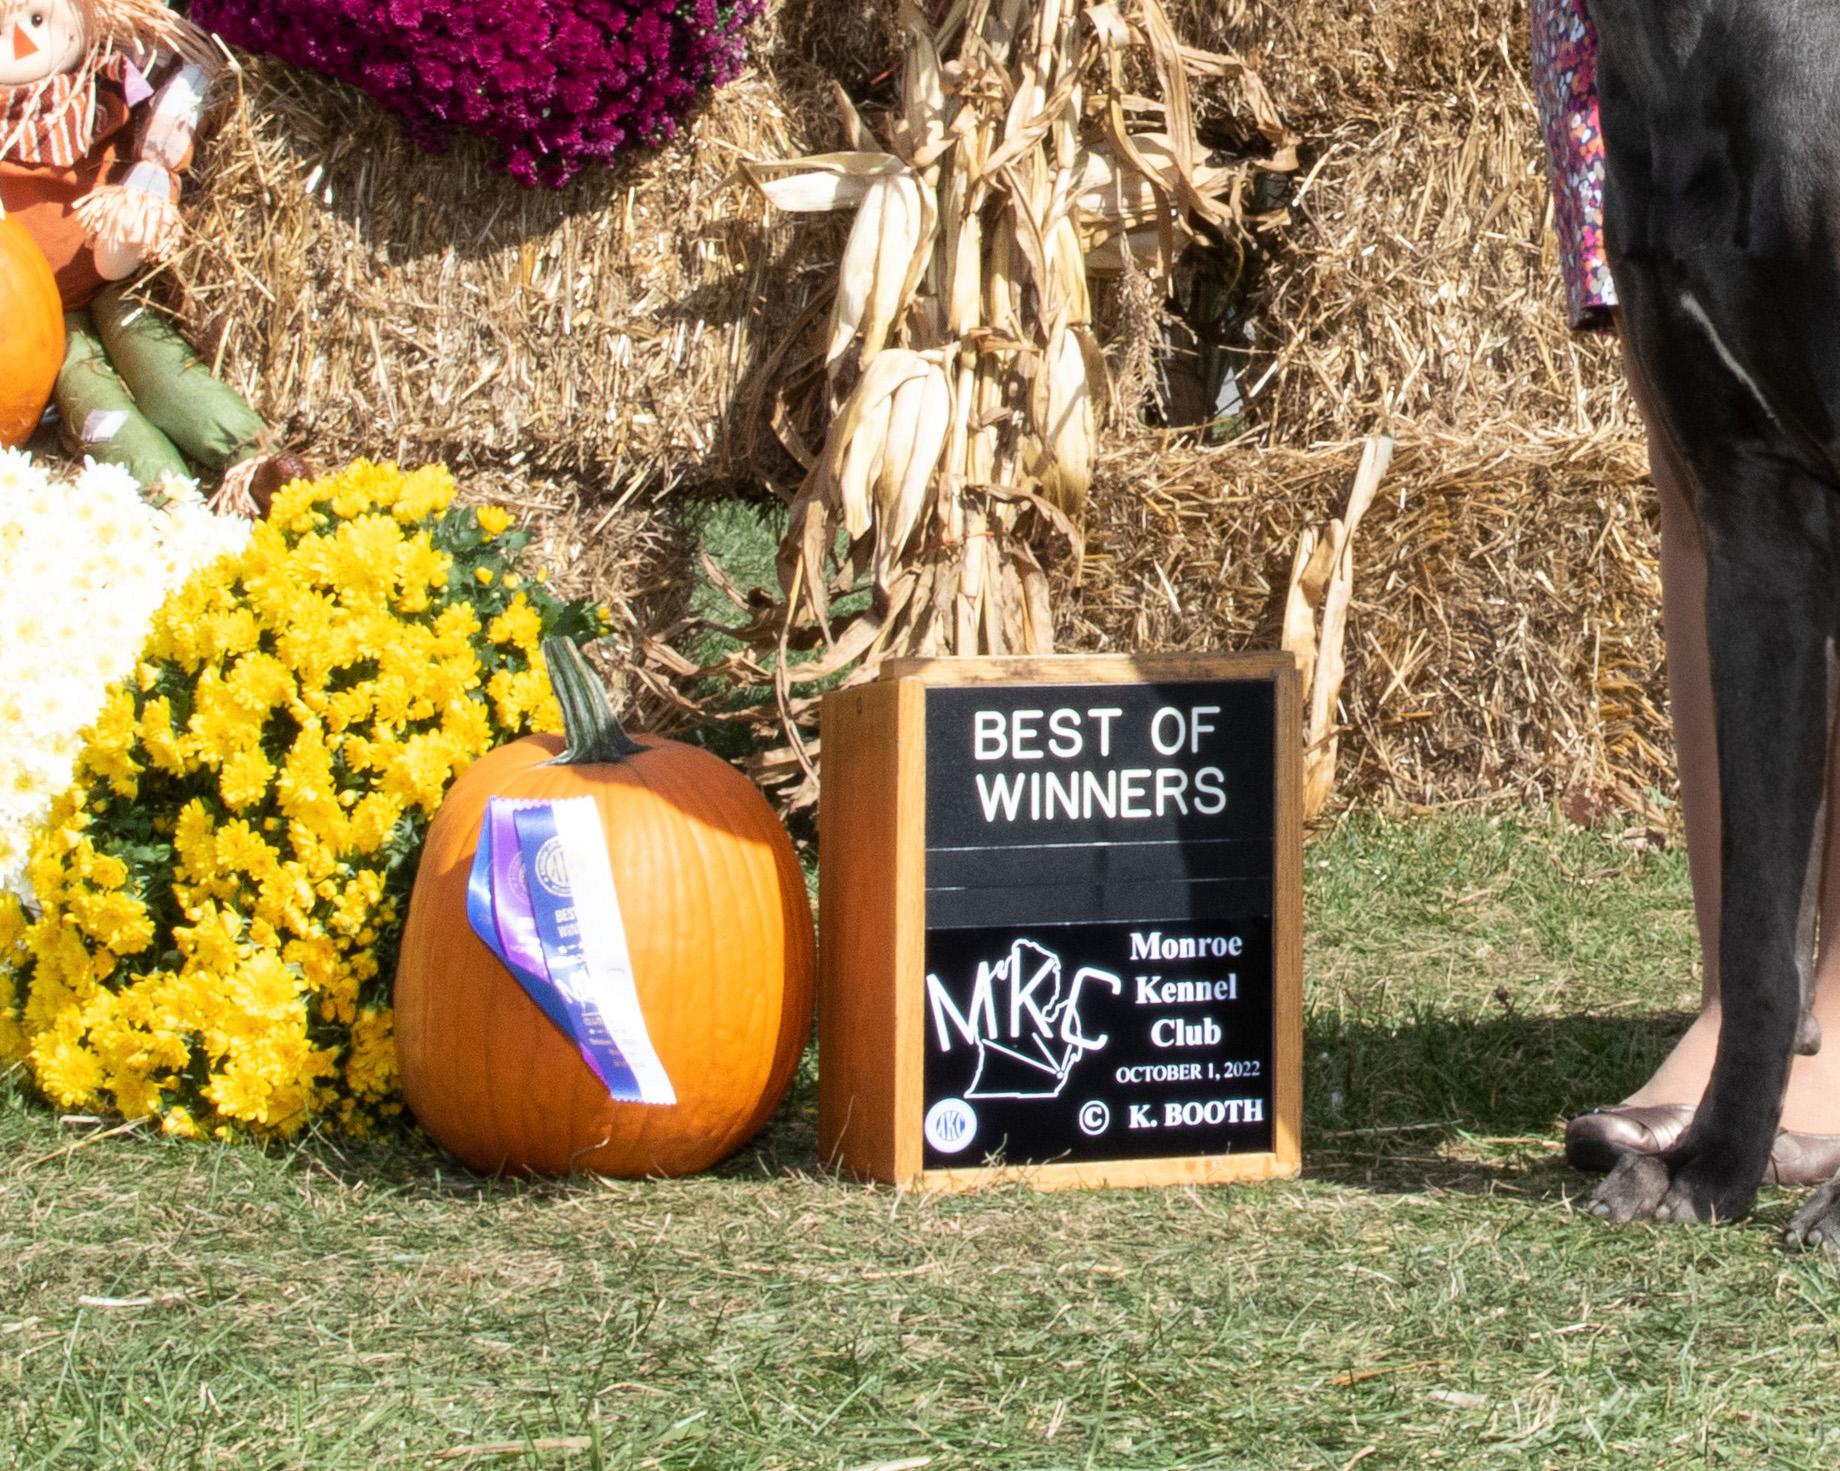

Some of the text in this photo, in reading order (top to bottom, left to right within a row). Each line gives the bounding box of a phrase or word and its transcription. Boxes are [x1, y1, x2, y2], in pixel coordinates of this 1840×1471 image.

[973, 706, 1221, 761] BEST OF
[974, 766, 1227, 823] WINNERS
[1129, 931, 1243, 961] Monroe
[1135, 973, 1237, 1005] Kennel
[1150, 1016, 1222, 1048] Club
[1115, 1060, 1260, 1084] OCTOBER 1, 2022
[1128, 1103, 1158, 1129] K.
[1163, 1098, 1264, 1128] BOOTH
